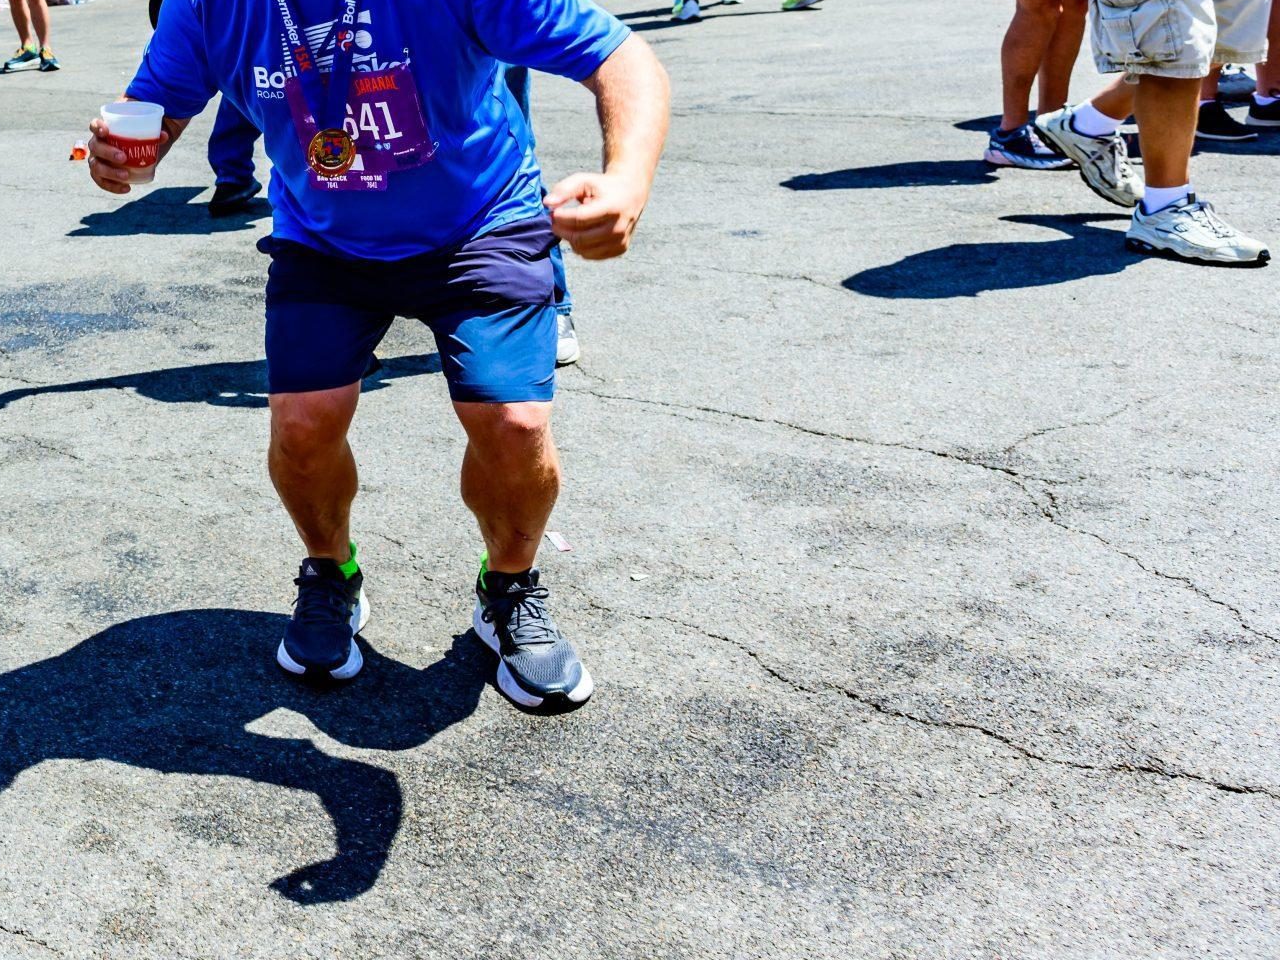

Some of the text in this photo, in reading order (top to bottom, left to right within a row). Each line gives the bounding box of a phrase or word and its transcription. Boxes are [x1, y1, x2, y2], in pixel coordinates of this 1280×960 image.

[293, 46, 313, 71] 15K
[256, 90, 285, 99] ROAD
[354, 74, 400, 96] SARANAC
